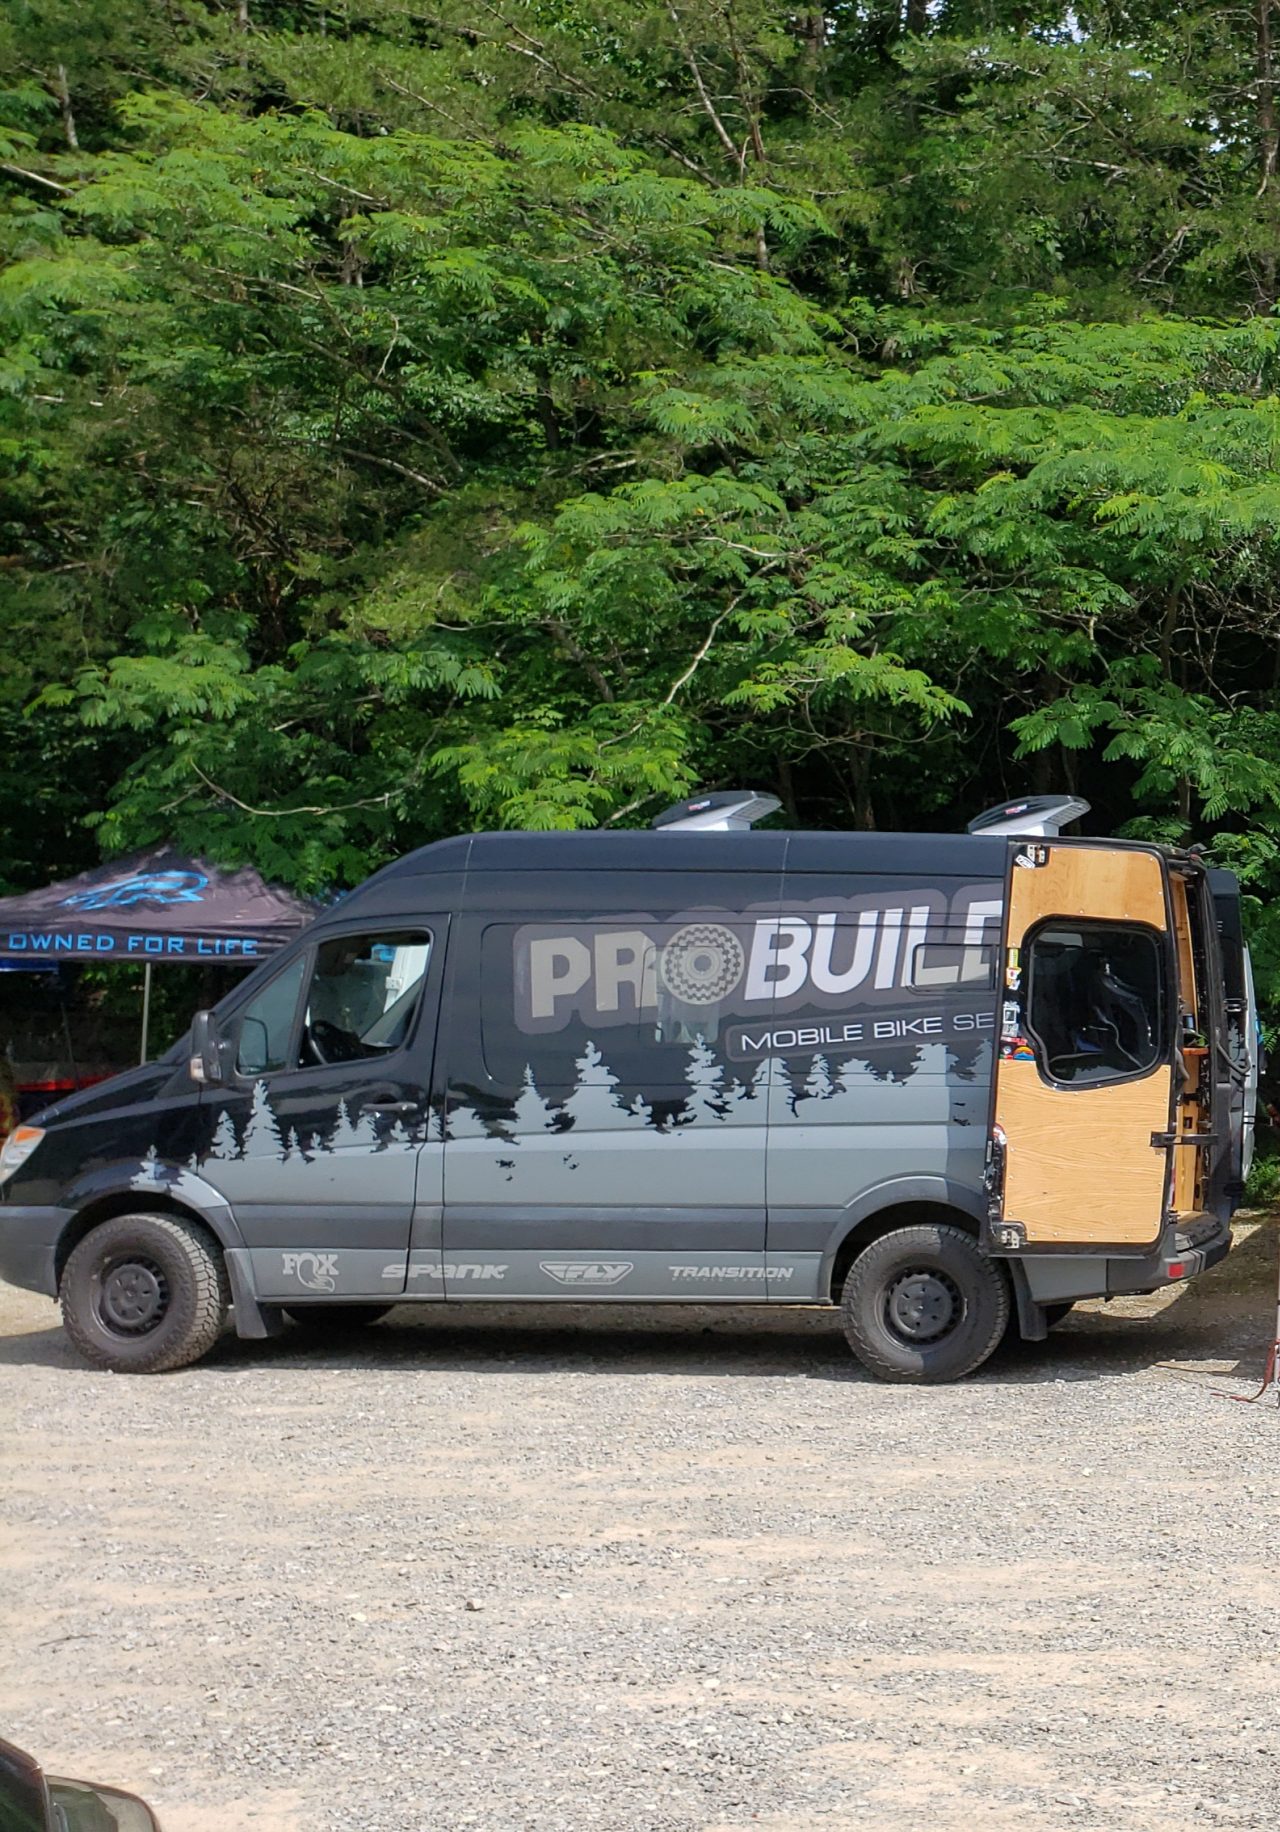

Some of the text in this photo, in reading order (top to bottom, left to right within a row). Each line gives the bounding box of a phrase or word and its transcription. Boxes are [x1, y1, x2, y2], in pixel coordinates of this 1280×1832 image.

[8, 933, 259, 955] OWNED FOR LIFE
[741, 1024, 864, 1051] MOBILE
[873, 1016, 943, 1039] BIKE
[282, 1252, 340, 1289] FOX
[668, 1265, 794, 1279] TRANSITION
